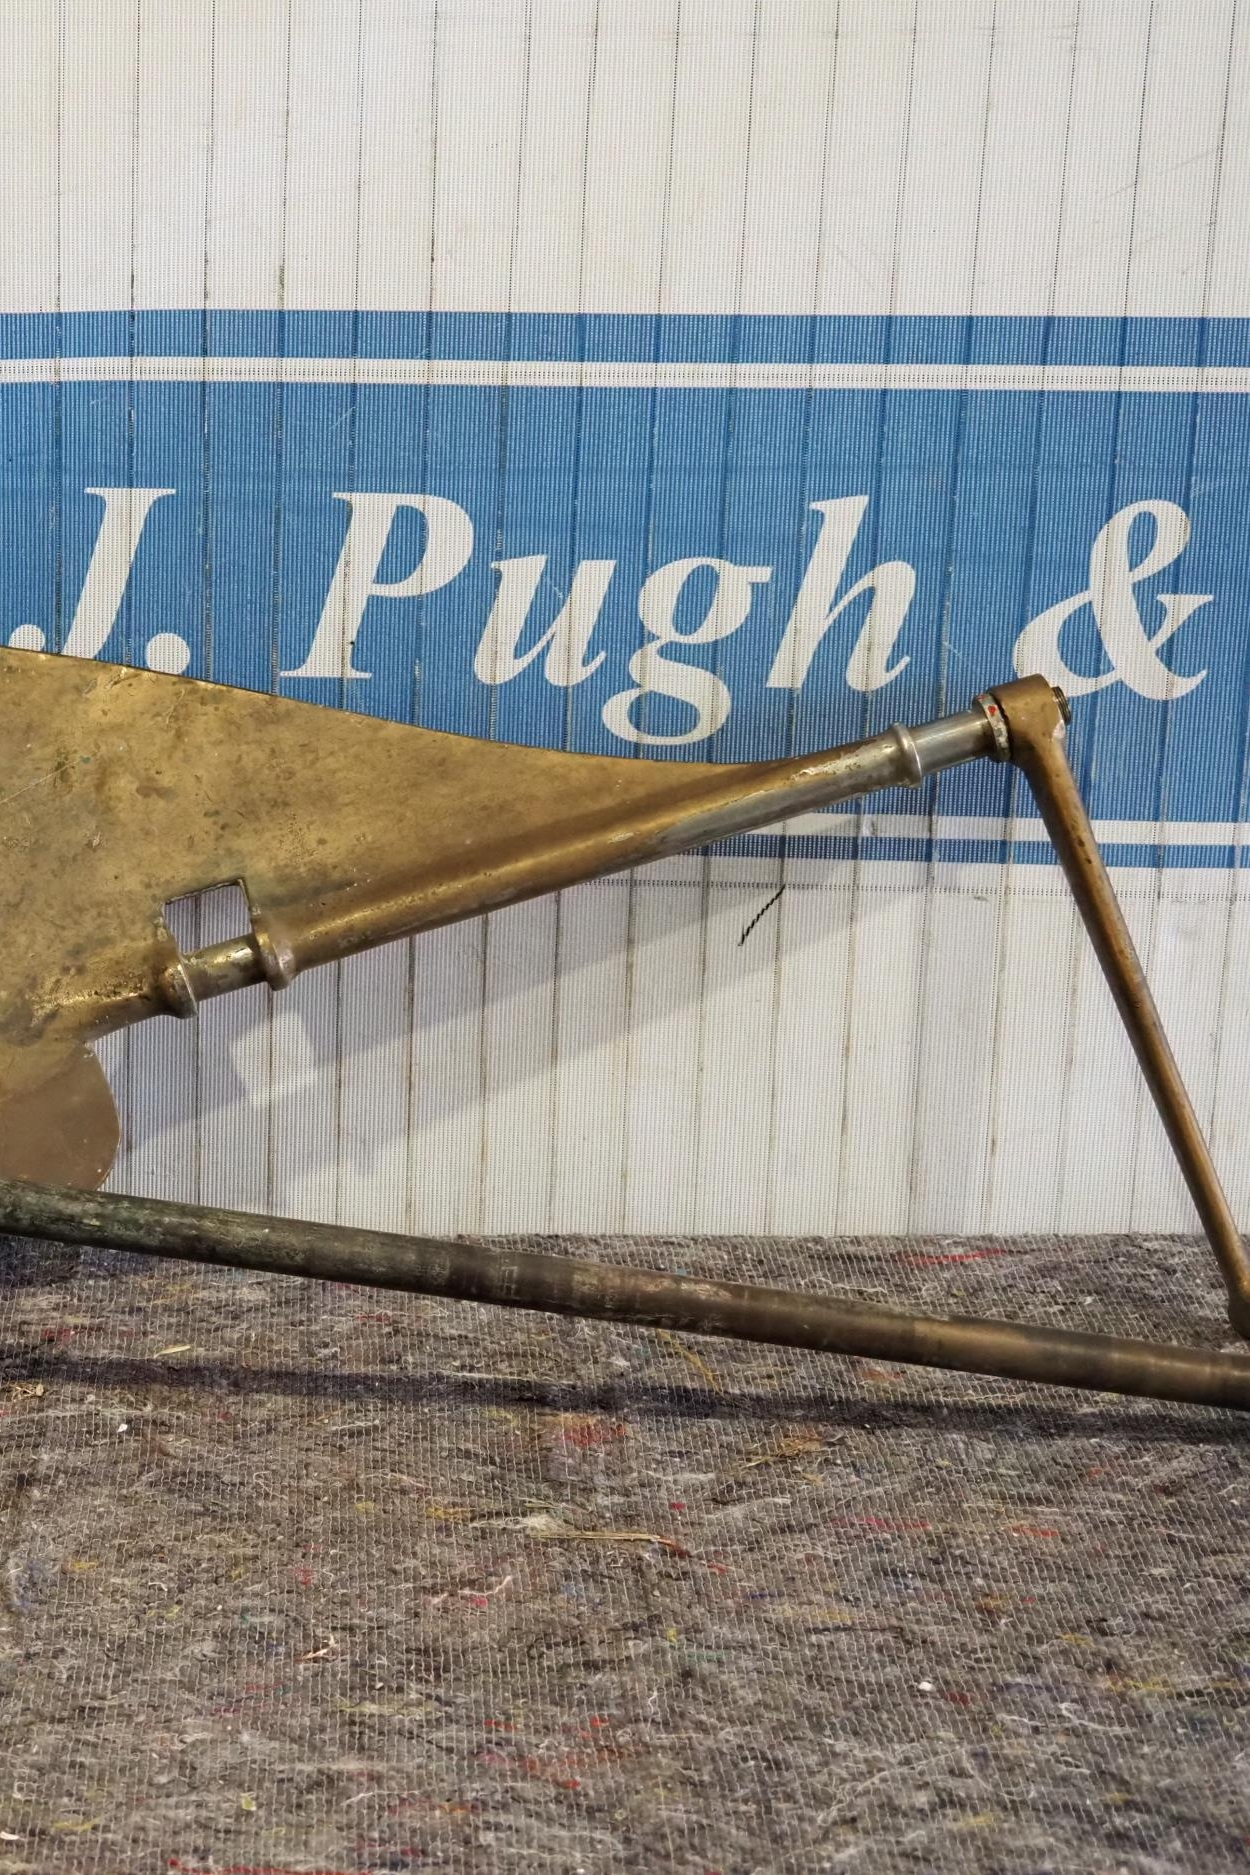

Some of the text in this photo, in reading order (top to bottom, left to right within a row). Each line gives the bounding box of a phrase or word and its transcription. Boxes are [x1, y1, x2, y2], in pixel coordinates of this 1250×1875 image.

[9, 487, 190, 675] J.
[279, 491, 918, 746] Pugh
[1013, 499, 1214, 701] &
